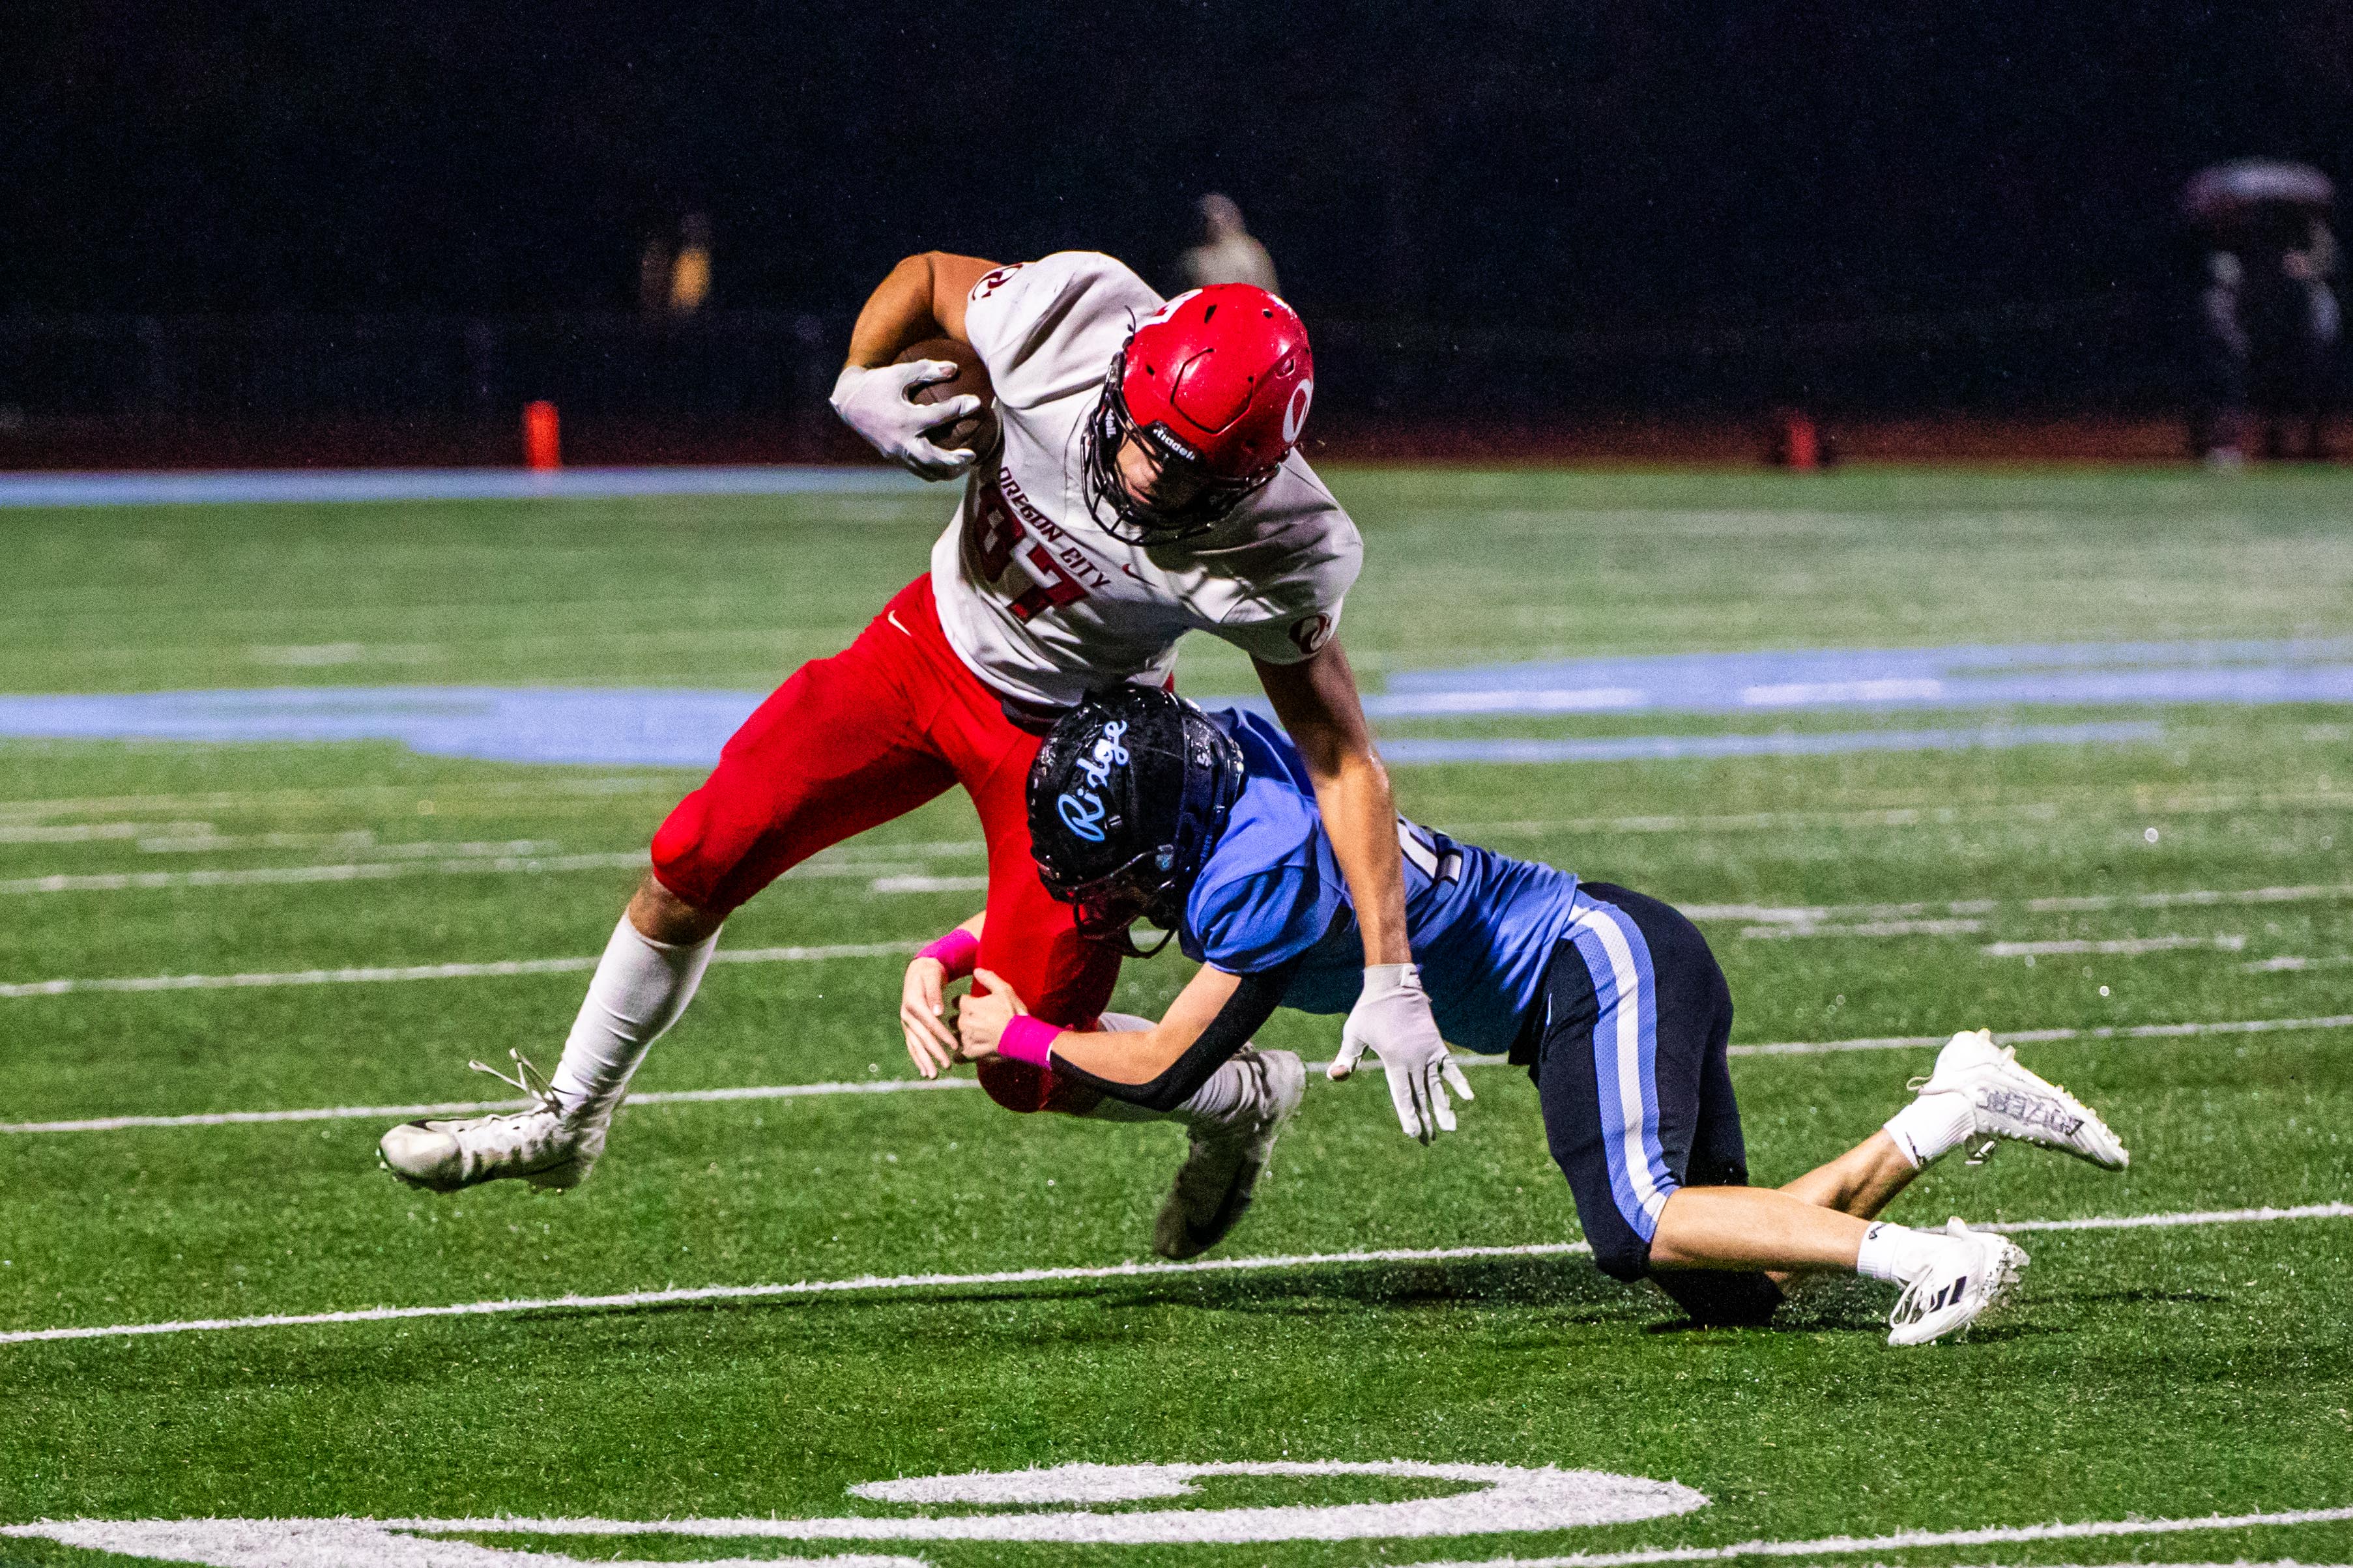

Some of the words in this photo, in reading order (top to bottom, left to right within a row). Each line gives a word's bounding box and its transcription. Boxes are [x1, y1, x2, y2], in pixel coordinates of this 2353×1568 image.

[1000, 466, 1064, 543] OREGON
[1060, 547, 1110, 589] CITY
[1056, 719, 1129, 842] Ridge
